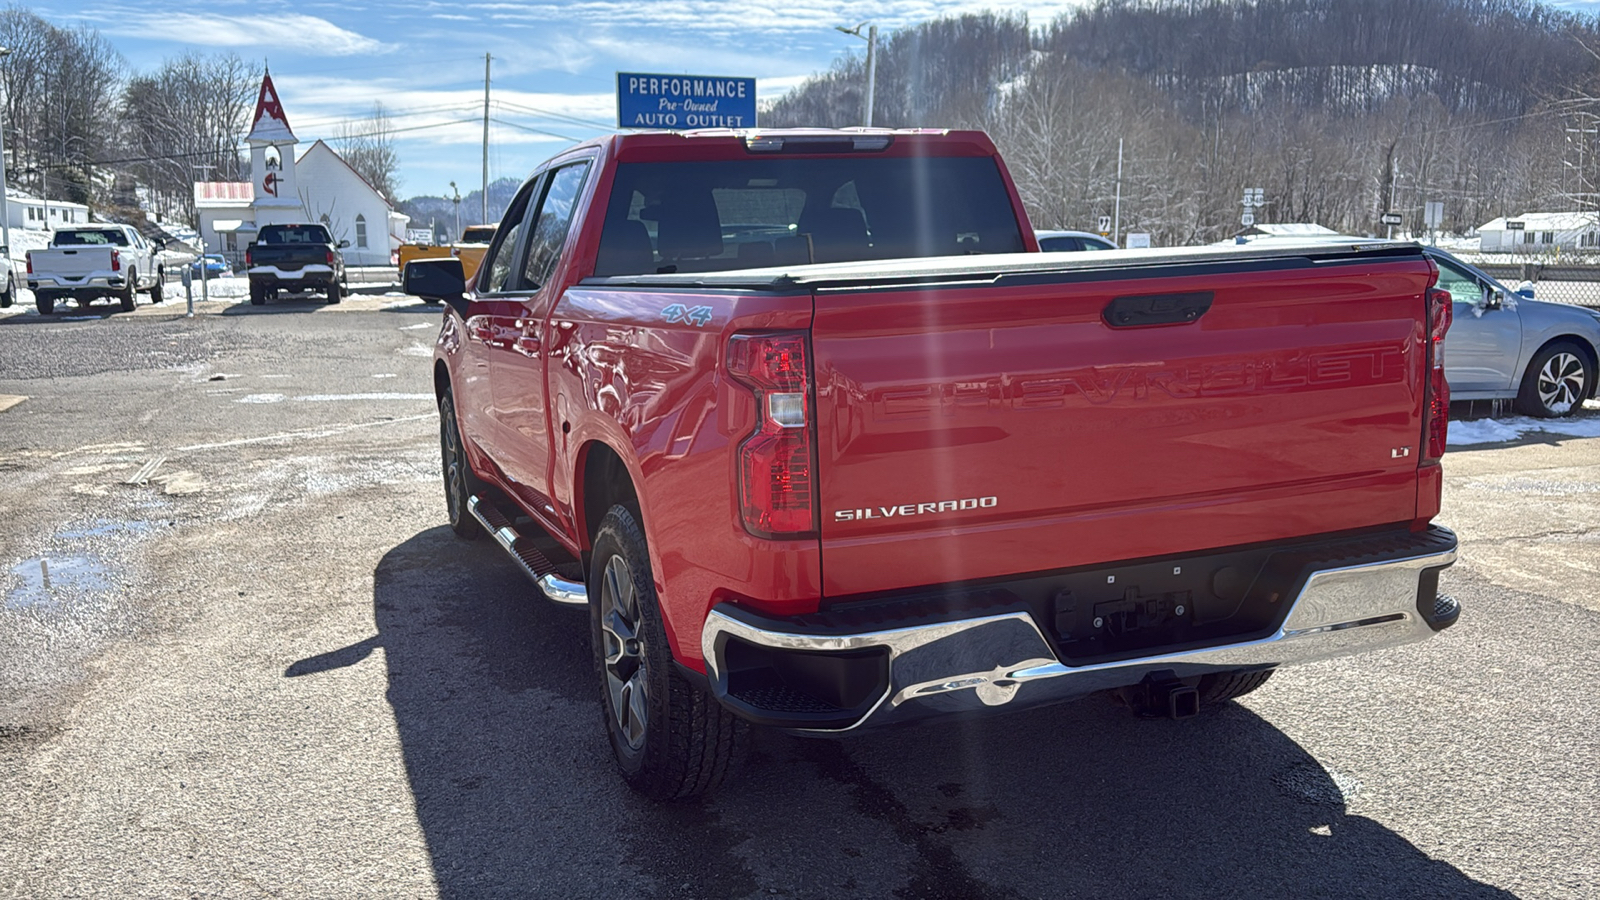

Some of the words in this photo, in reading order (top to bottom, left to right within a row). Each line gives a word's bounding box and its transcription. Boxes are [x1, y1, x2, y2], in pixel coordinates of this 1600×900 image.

[629, 77, 746, 98] PERFORMANCE
[658, 98, 718, 112] Pre-Owned
[634, 113, 677, 126] AUTO
[686, 114, 744, 127] OUTLET
[1391, 446, 1413, 459] LT
[834, 496, 998, 522] SILVERADO
